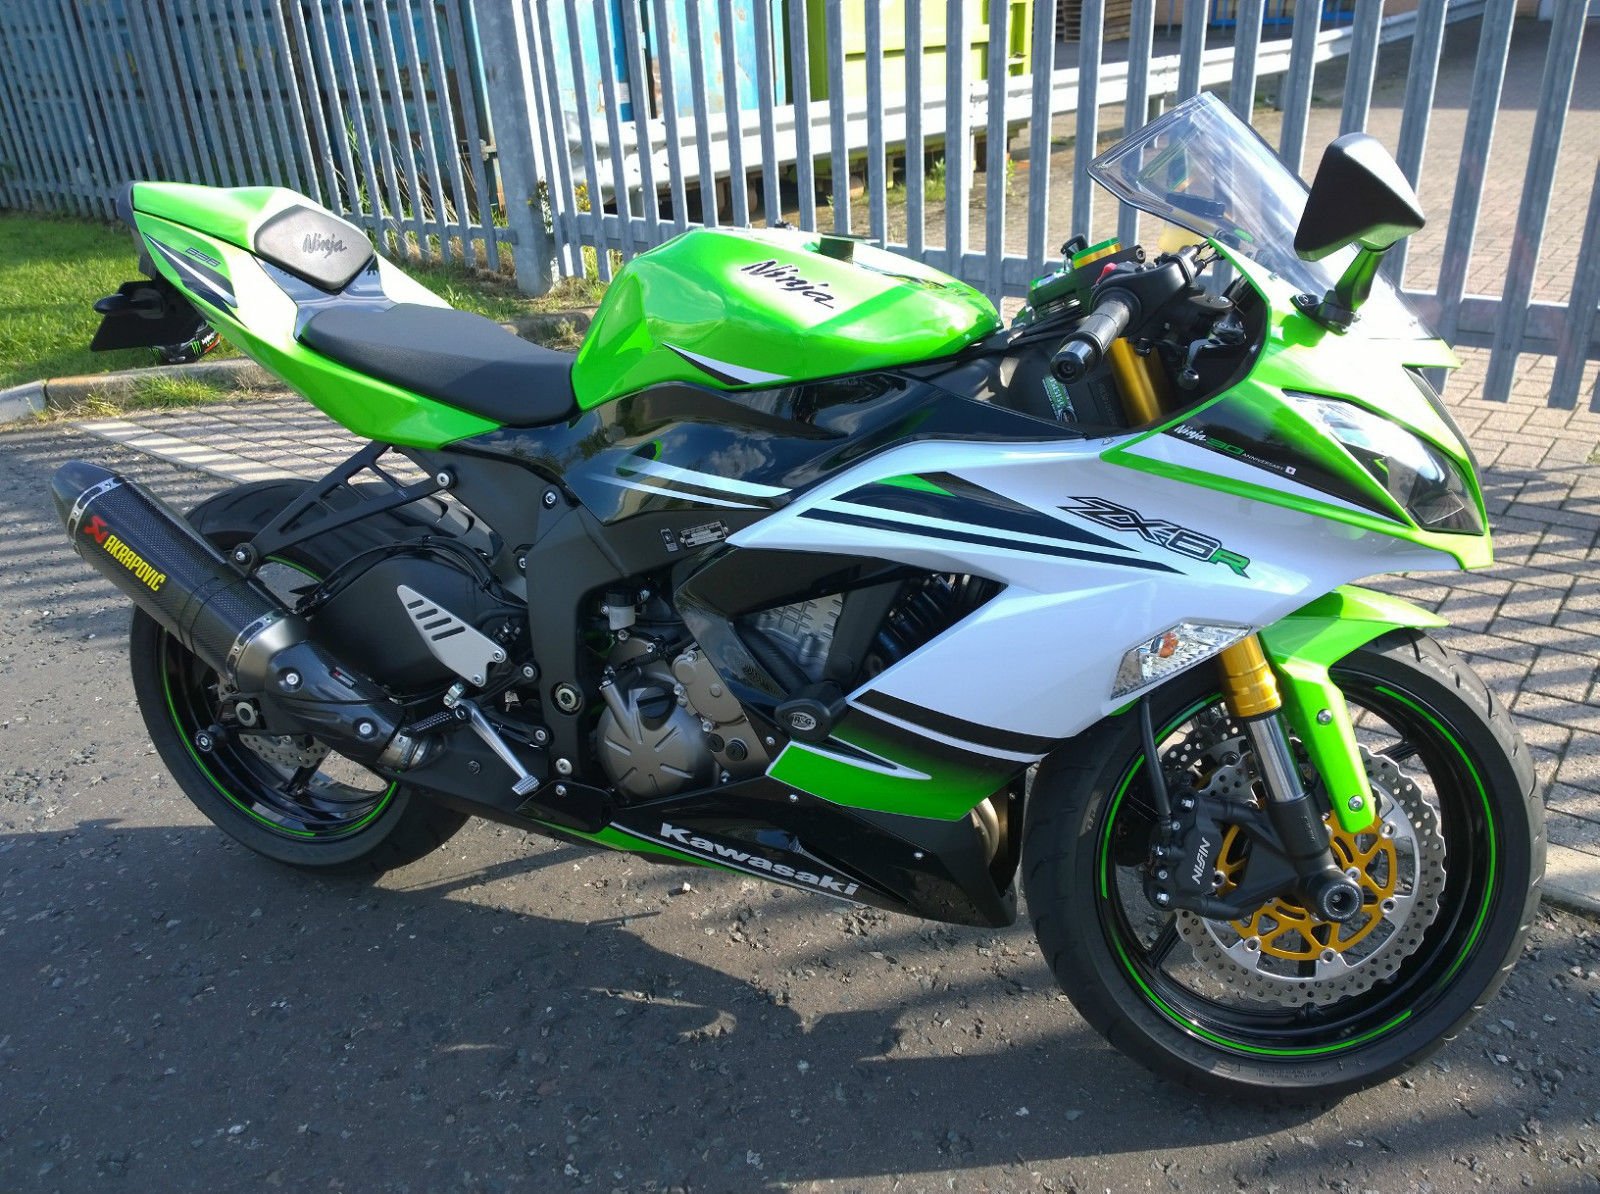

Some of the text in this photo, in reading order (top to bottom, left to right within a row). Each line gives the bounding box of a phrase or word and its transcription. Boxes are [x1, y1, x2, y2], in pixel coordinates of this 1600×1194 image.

[302, 232, 348, 259] Ninja
[740, 260, 835, 310] Ninja
[1173, 424, 1207, 442] Ninja
[660, 822, 860, 896] Kawasaki
